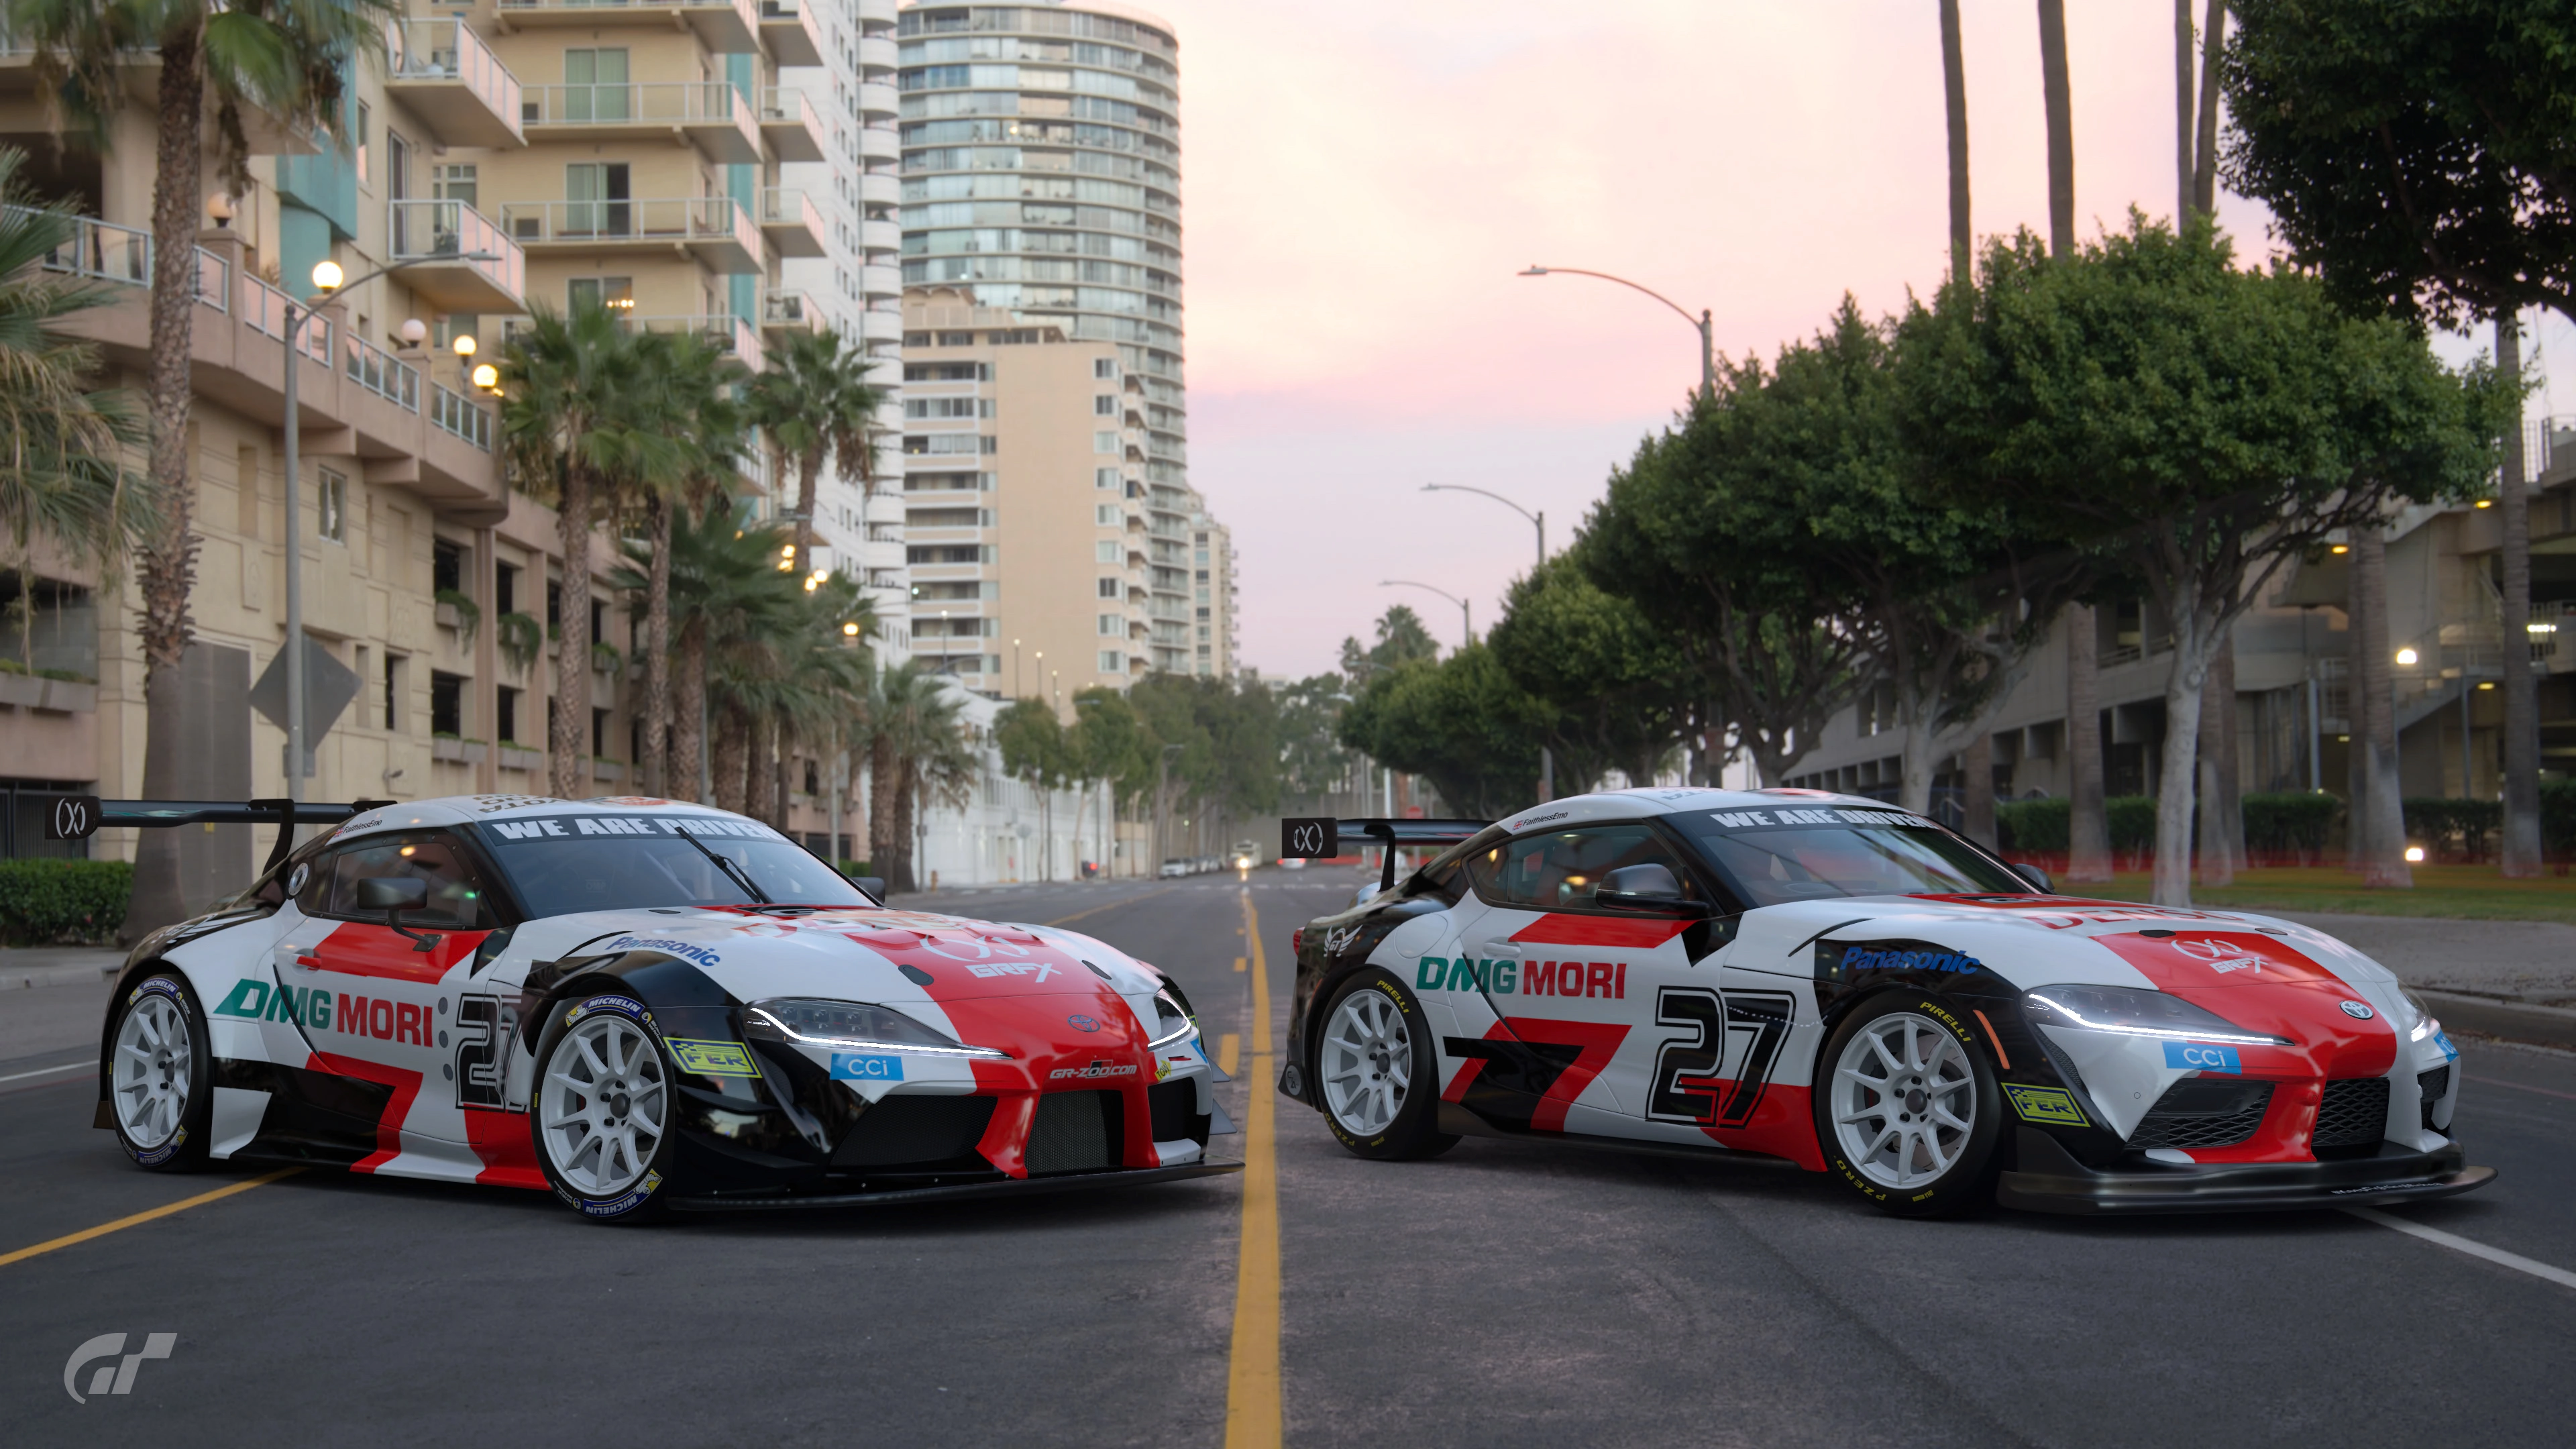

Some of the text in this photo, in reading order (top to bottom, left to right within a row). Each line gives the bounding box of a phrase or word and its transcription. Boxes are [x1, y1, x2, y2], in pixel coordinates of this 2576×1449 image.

[492, 820, 570, 839] WE
[574, 818, 657, 835] ARE
[1523, 812, 1568, 826] FaithlessEmo
[1710, 811, 1776, 828] WE
[1774, 809, 1842, 824] ARE
[2022, 908, 2245, 930] DENSO
[605, 936, 720, 967] Panasonic
[1839, 947, 1980, 974] Panasonic
[142, 979, 176, 993] MICHELIN
[1416, 956, 1627, 999] DMG MORI
[588, 998, 641, 1012] MICHELIN
[1377, 979, 1409, 1014] PIRELLI
[212, 978, 331, 1029] DMG
[337, 993, 433, 1048] MORI
[1919, 1002, 1972, 1042] PIRELLI
[684, 1051, 748, 1067] FER
[1645, 985, 1797, 1130] 27
[1156, 1065, 1171, 1080] TOW
[2018, 1097, 2074, 1114] FER
[139, 1147, 172, 1165] MICHELIN
[585, 1194, 638, 1214] MICHELIN
